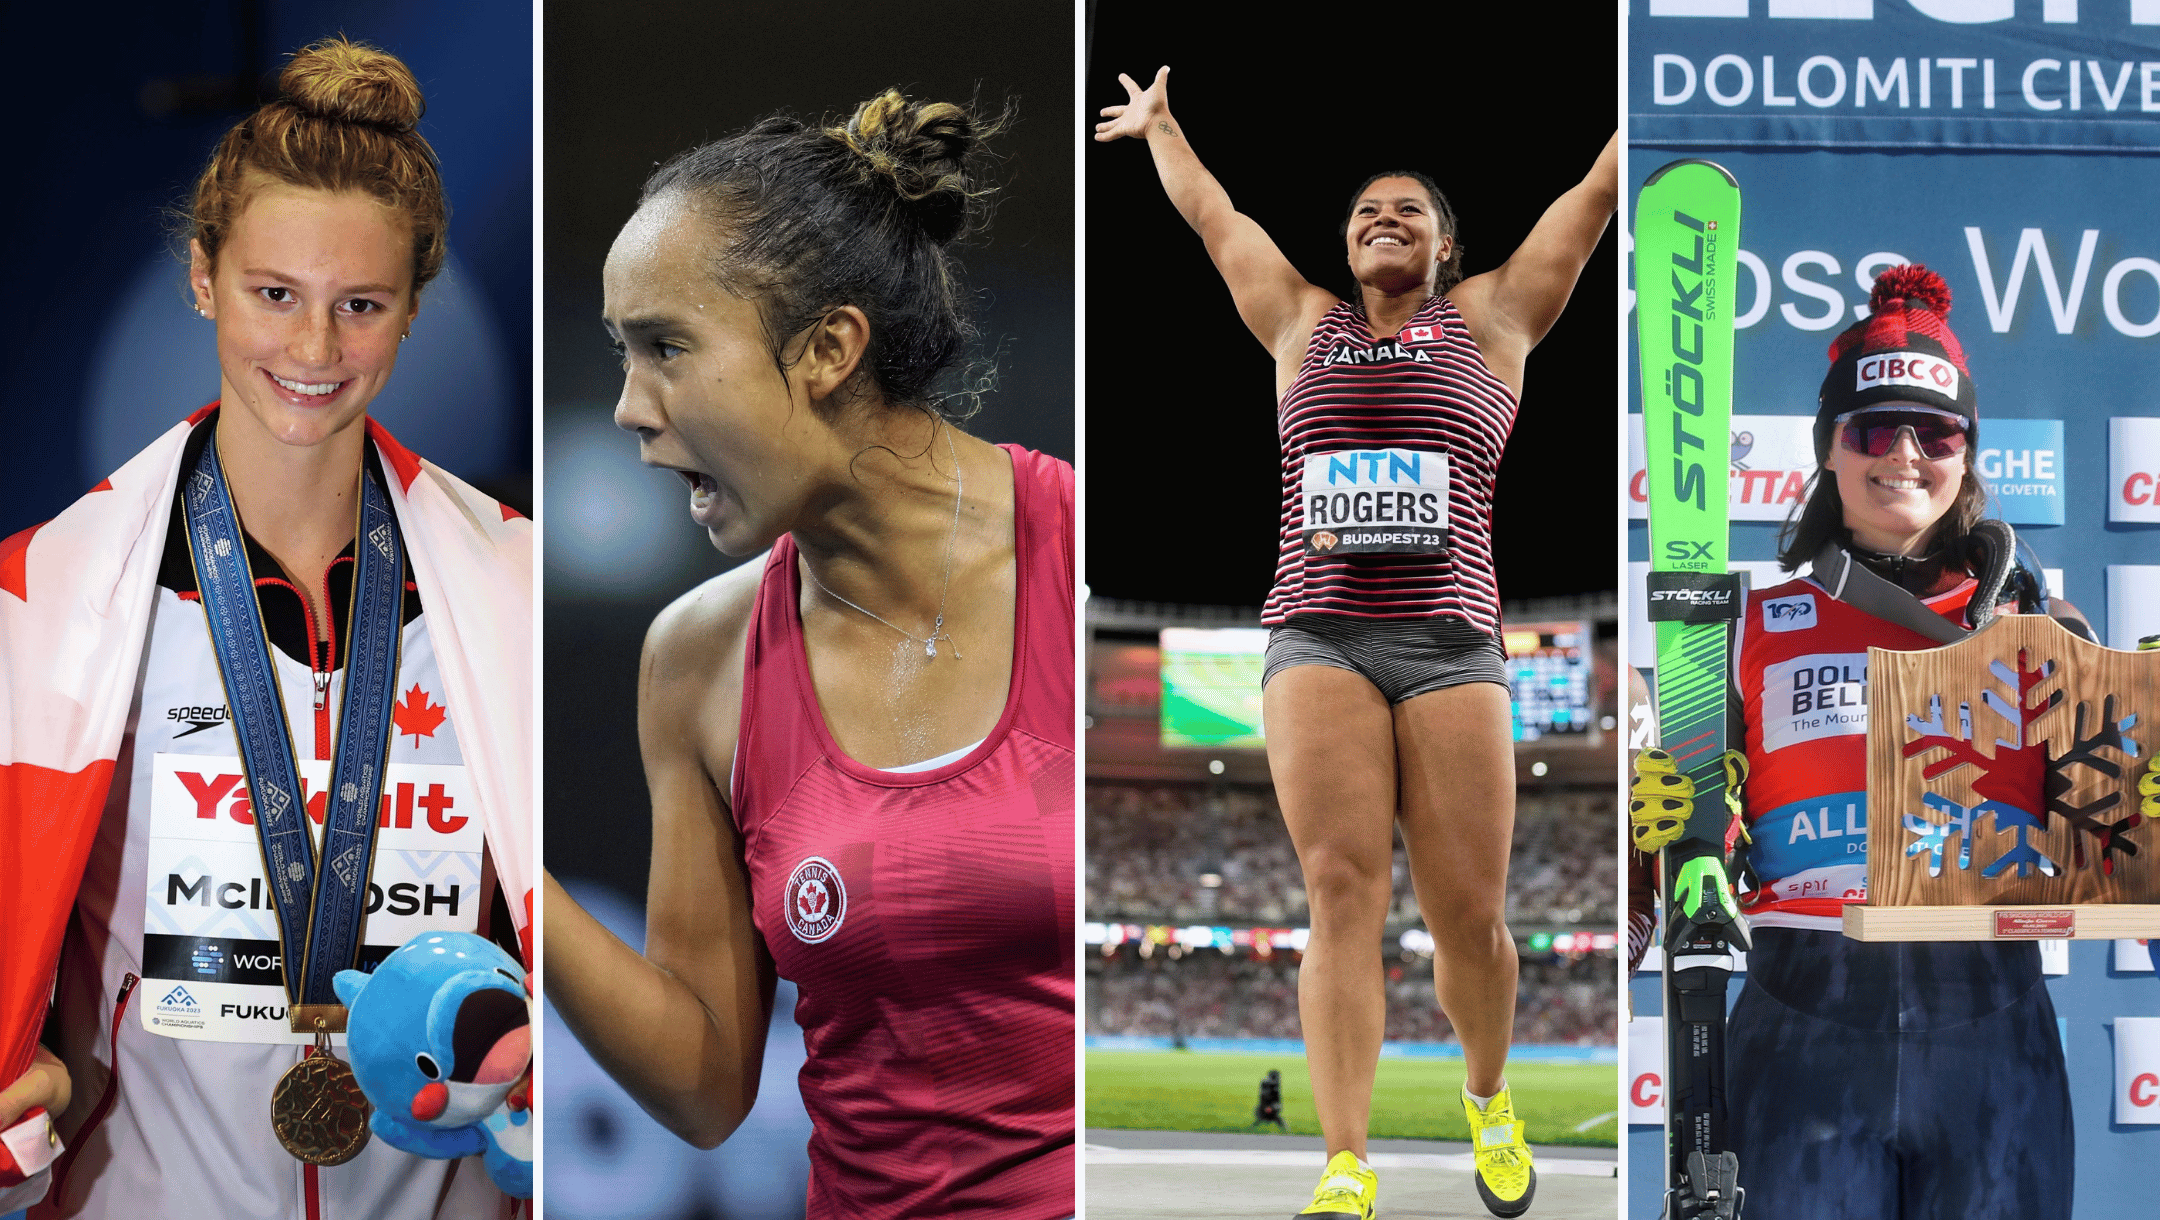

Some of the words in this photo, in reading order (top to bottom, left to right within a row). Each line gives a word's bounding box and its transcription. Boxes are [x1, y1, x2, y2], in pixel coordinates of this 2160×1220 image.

[1653, 54, 1995, 109] DOLOMITI
[1706, 233, 1717, 275] MADE
[1706, 278, 1715, 320] SWISS
[1323, 341, 1433, 367] CANADA
[1665, 209, 1706, 512] STÖCKLI
[1861, 359, 1925, 382] CIBC
[1328, 451, 1421, 486] NTN
[2002, 484, 2056, 496] CIVETTA
[1309, 491, 1439, 526] ROGERS
[1342, 532, 1421, 546] BUDAPEST
[1422, 533, 1440, 546] 23
[1665, 541, 1715, 560] SX
[1672, 562, 1708, 570] LASER
[1650, 589, 1732, 601] STÖCKLI
[1793, 665, 1867, 691] DOL
[1791, 718, 1820, 732] The
[794, 866, 829, 888] TENNIS
[797, 913, 836, 936] CANADA
[220, 1003, 289, 1021] FUKU
